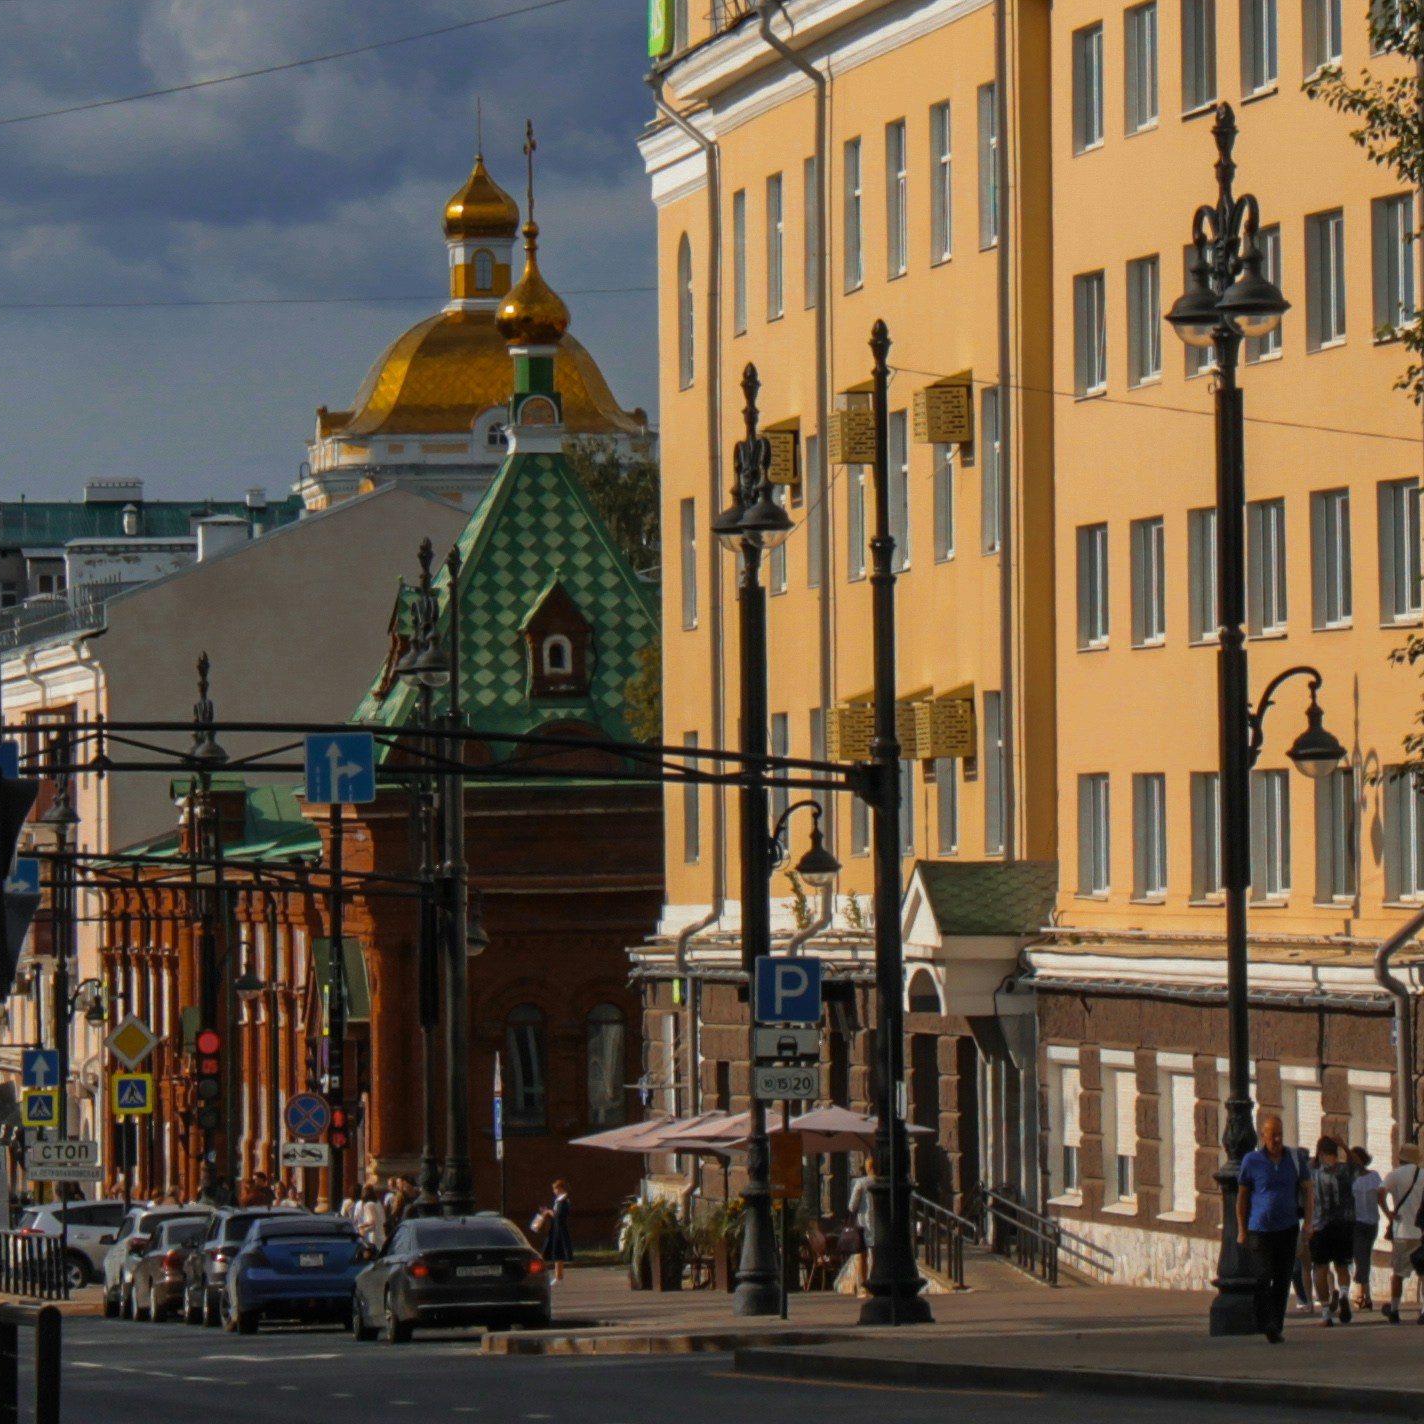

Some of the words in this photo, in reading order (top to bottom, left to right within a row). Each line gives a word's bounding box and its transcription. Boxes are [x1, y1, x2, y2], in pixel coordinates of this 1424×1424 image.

[775, 964, 809, 1015] P
[777, 1078, 788, 1090] 15
[793, 1077, 811, 1091] 20
[42, 1145, 89, 1159] СТОП
